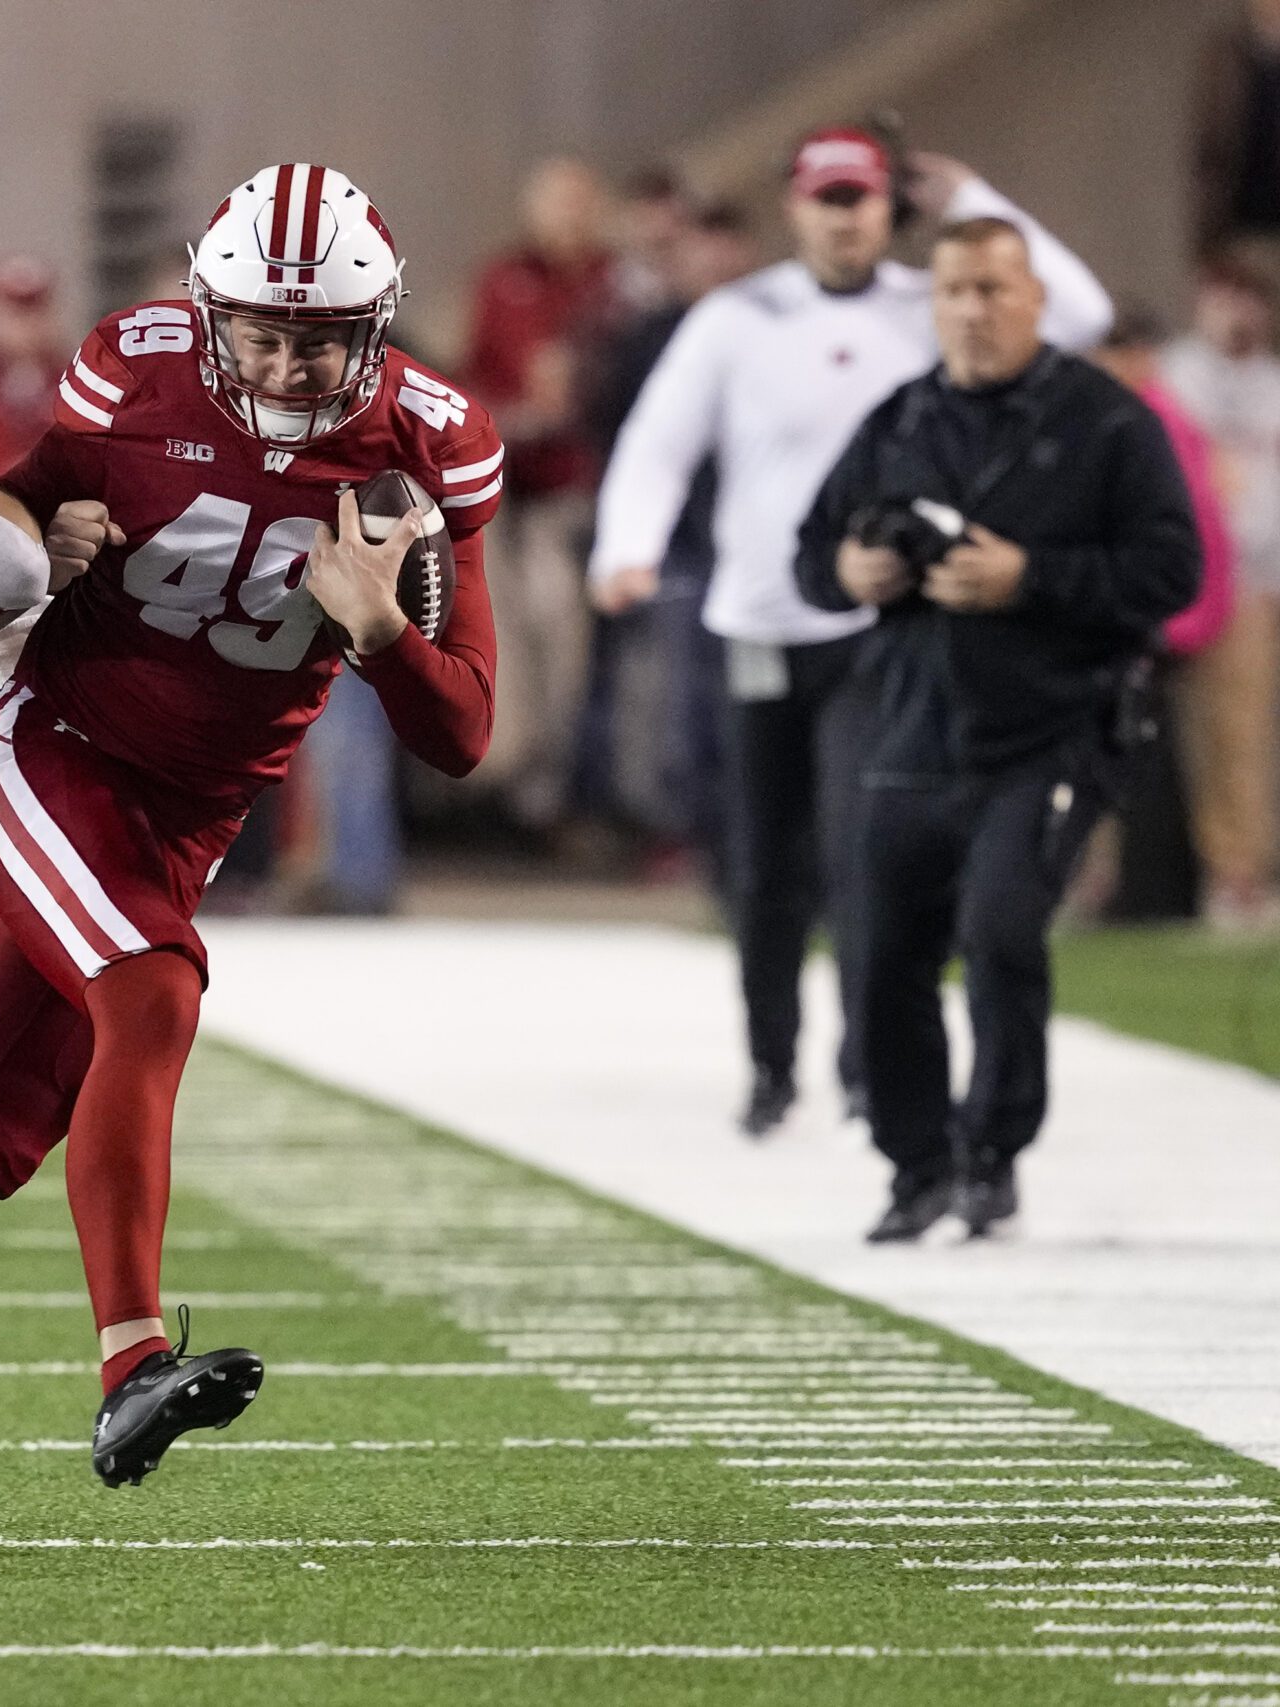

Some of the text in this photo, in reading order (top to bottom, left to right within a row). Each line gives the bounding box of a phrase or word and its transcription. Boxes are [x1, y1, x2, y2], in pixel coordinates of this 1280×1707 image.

[118, 306, 194, 357] 49
[397, 366, 469, 432] 49
[263, 450, 295, 475] W
[123, 492, 328, 672] 49
